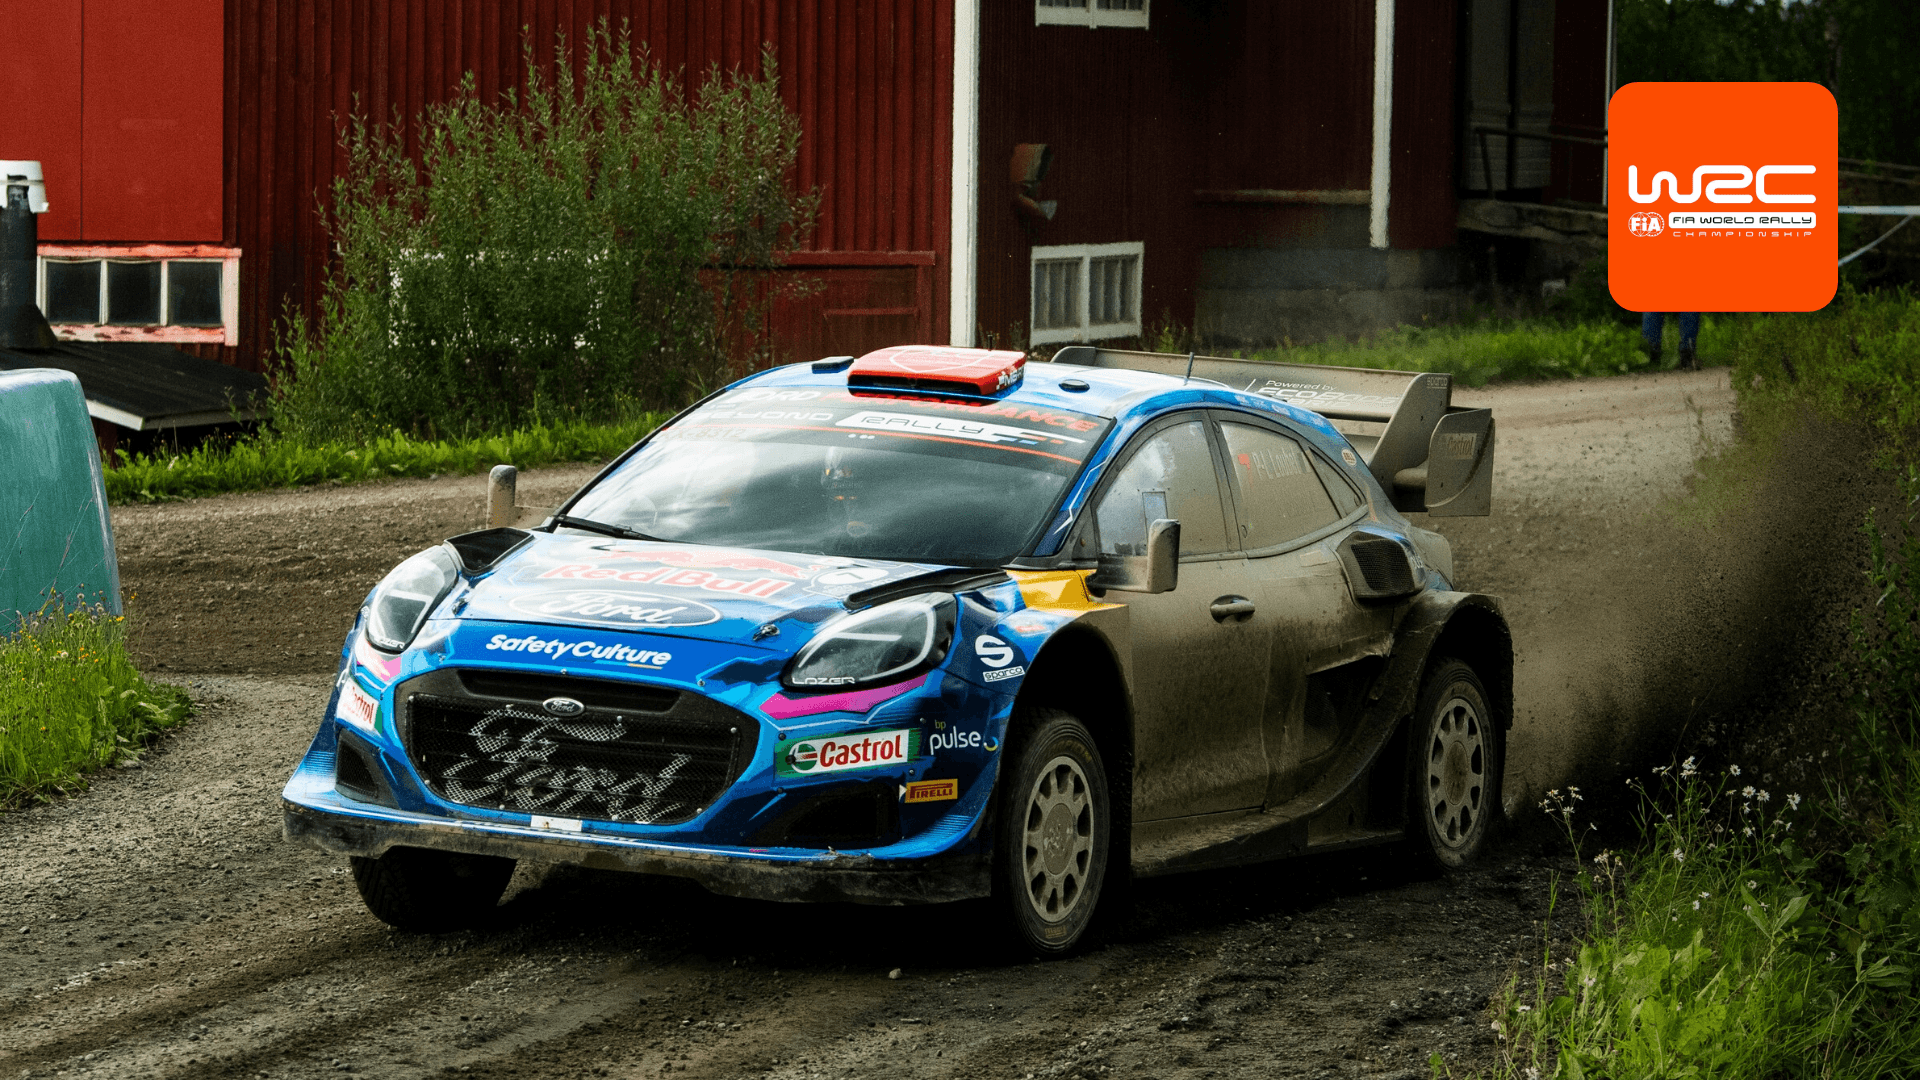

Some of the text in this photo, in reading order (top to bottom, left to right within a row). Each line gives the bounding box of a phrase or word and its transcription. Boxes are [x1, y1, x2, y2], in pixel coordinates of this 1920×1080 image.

[1265, 380, 1321, 390] Powered
[860, 415, 985, 434] RALLY
[540, 591, 687, 623] Ford
[485, 634, 673, 665] SafetyCulture
[984, 667, 1023, 680] sparco
[550, 699, 575, 713] Ford
[934, 719, 947, 730] bp
[929, 725, 982, 755] pulse
[820, 734, 903, 768] Castrol
[908, 782, 954, 799] PIRELLI
